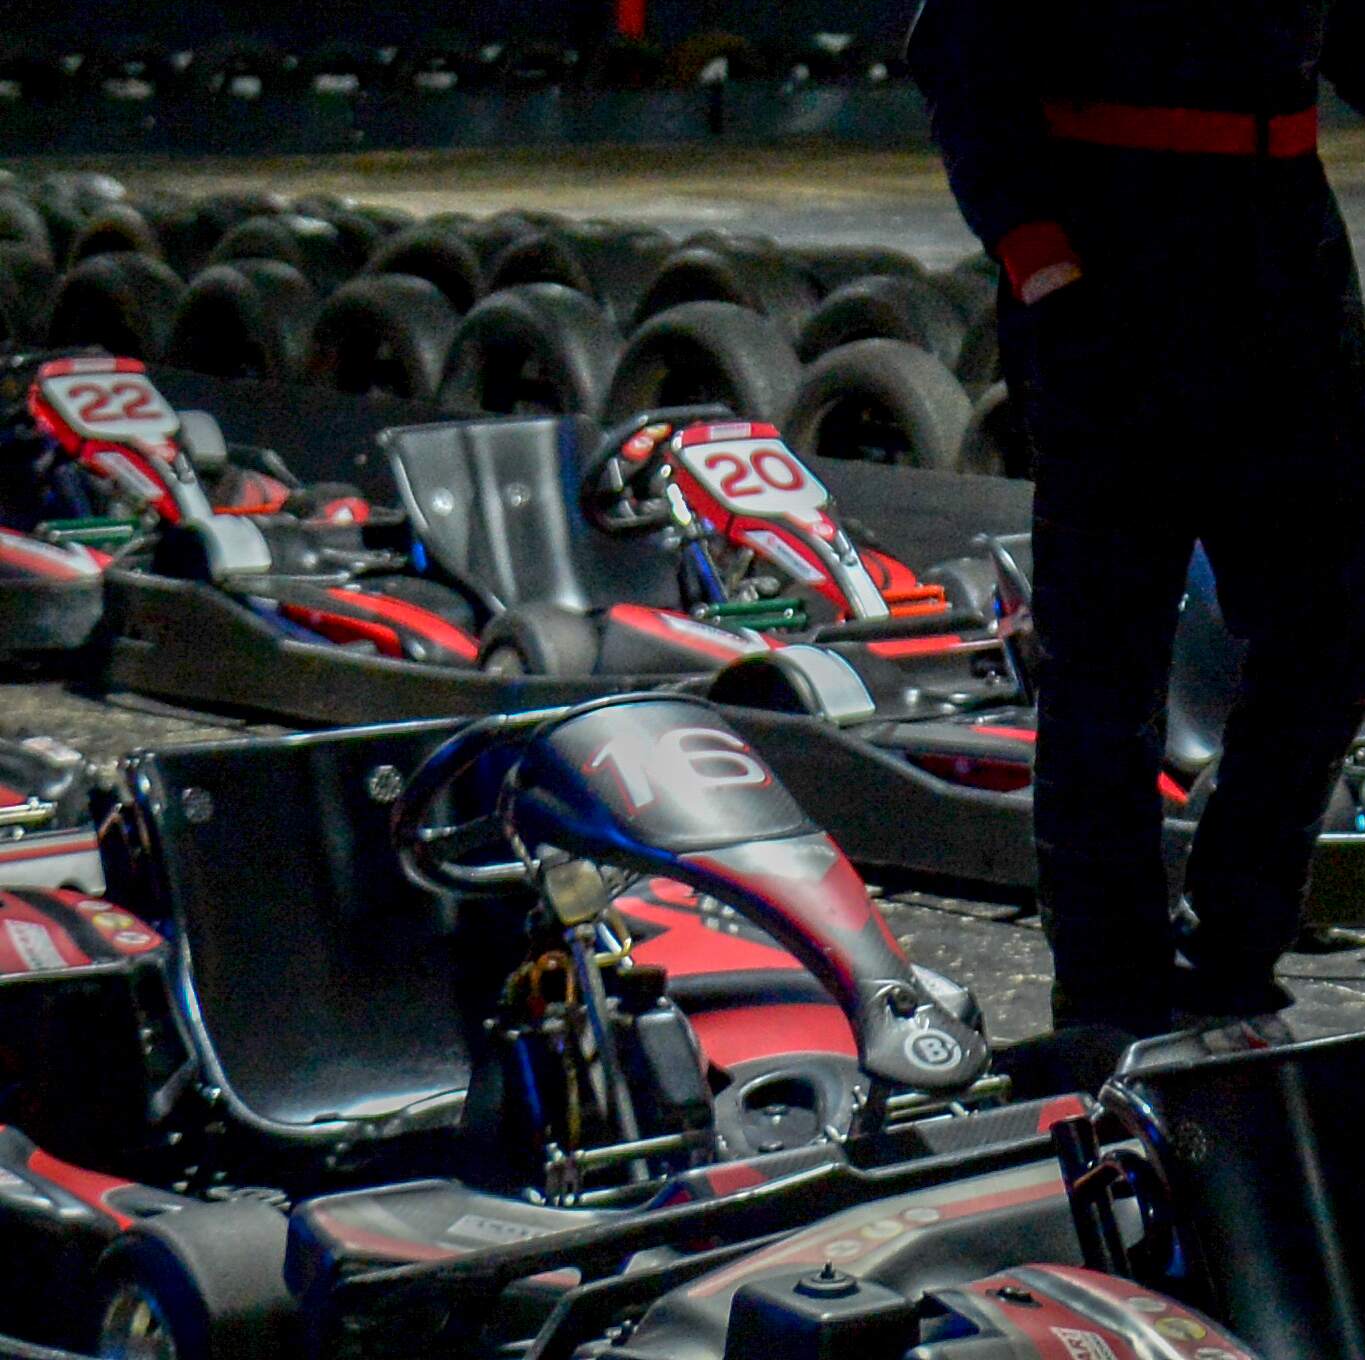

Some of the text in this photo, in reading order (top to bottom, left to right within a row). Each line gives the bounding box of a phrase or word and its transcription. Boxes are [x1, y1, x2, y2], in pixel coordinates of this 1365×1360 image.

[67, 382, 163, 423] 22
[704, 450, 805, 499] 20
[582, 724, 771, 813] 16
